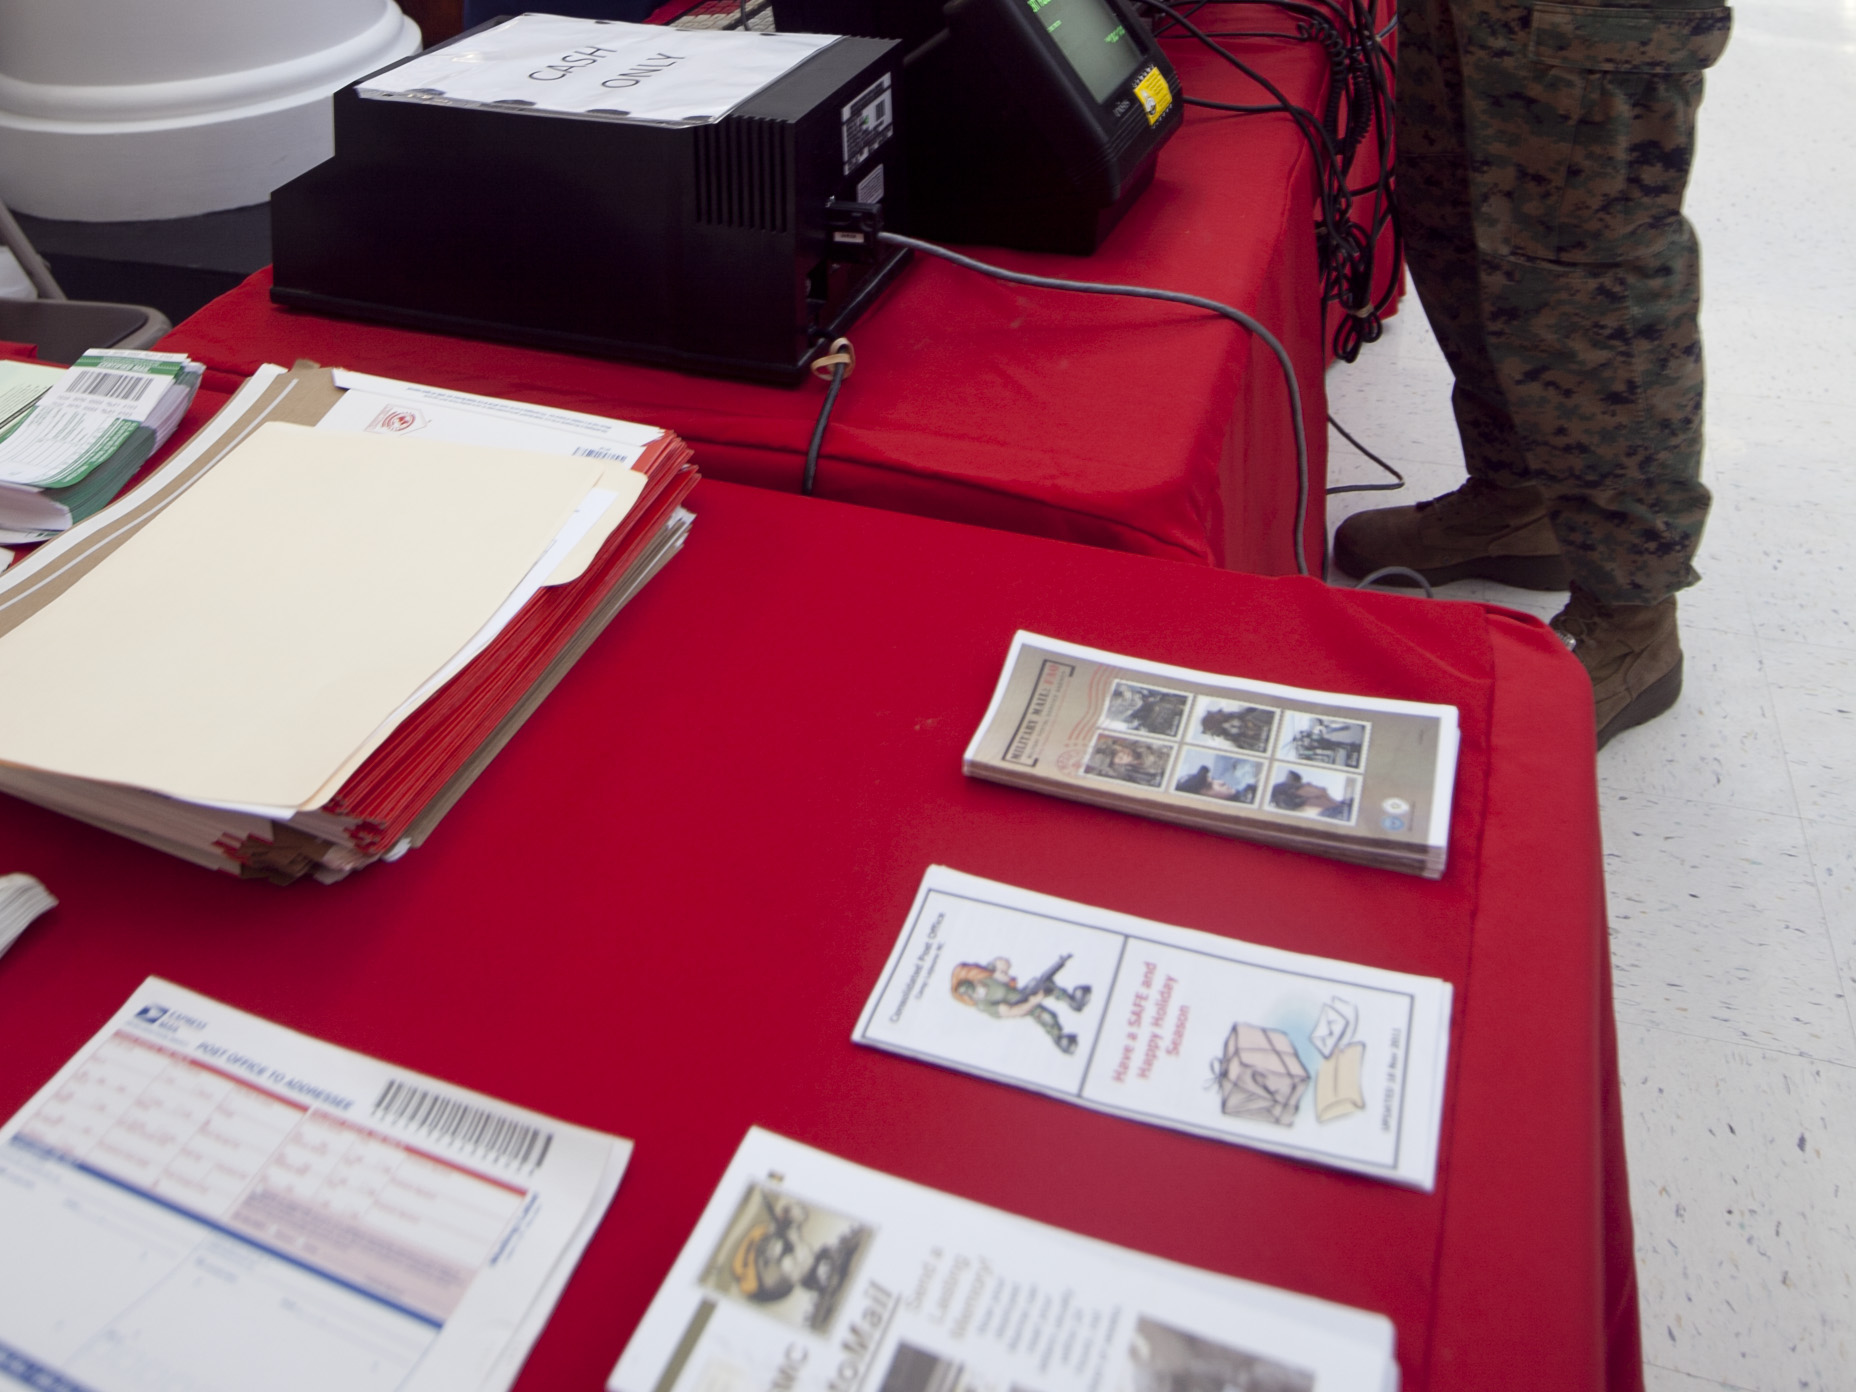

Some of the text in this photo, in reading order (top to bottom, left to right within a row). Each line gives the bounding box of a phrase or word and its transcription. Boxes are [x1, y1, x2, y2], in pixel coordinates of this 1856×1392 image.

[528, 45, 618, 82] CASH
[601, 52, 686, 89] ONLY
[1010, 719, 1039, 760] MILITARY
[889, 912, 946, 1023] Consolidated Post Office
[169, 1009, 208, 1031] EXPRESS
[1111, 960, 1157, 1083] Have a SAFE and
[1136, 974, 1178, 1079] Happy Holiday
[1165, 1004, 1190, 1057] Season
[195, 1040, 357, 1112] POST OFFICE TO ADDRESSEE
[1381, 1086, 1395, 1132] UPDATED
[903, 1246, 944, 1313] Send a
[927, 1251, 971, 1325] Lasting
